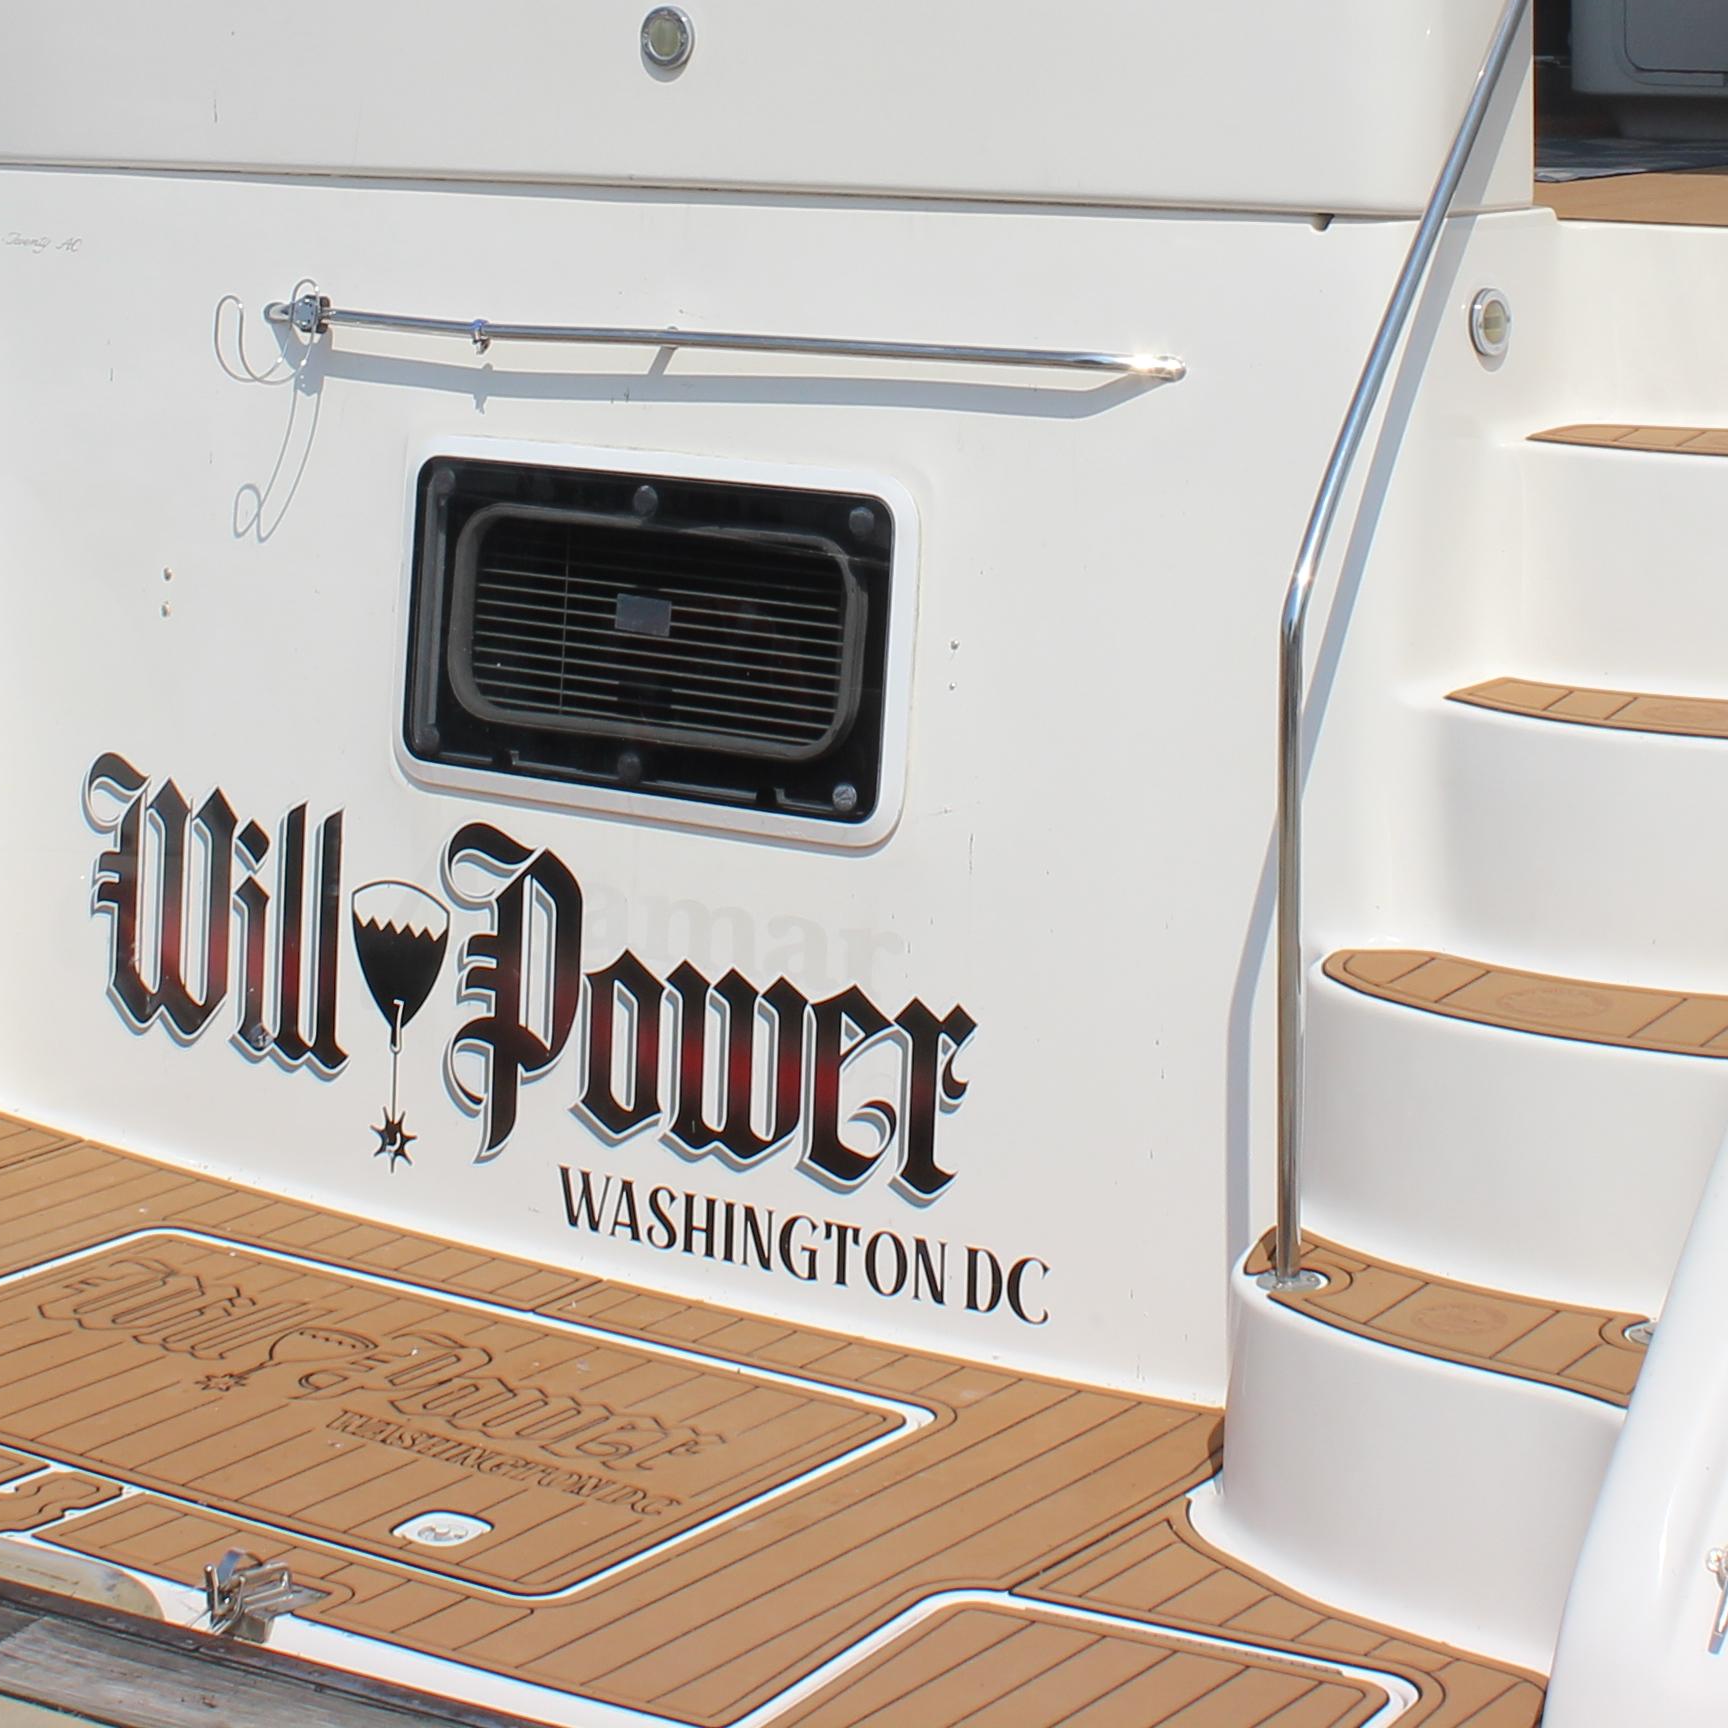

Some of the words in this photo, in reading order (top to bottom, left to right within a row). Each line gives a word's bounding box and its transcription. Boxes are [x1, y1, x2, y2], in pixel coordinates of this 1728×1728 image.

[80, 749, 352, 1080] Will
[438, 819, 979, 1210] Power
[557, 1164, 948, 1307] WASHINGTON
[963, 1244, 1051, 1325] DC
